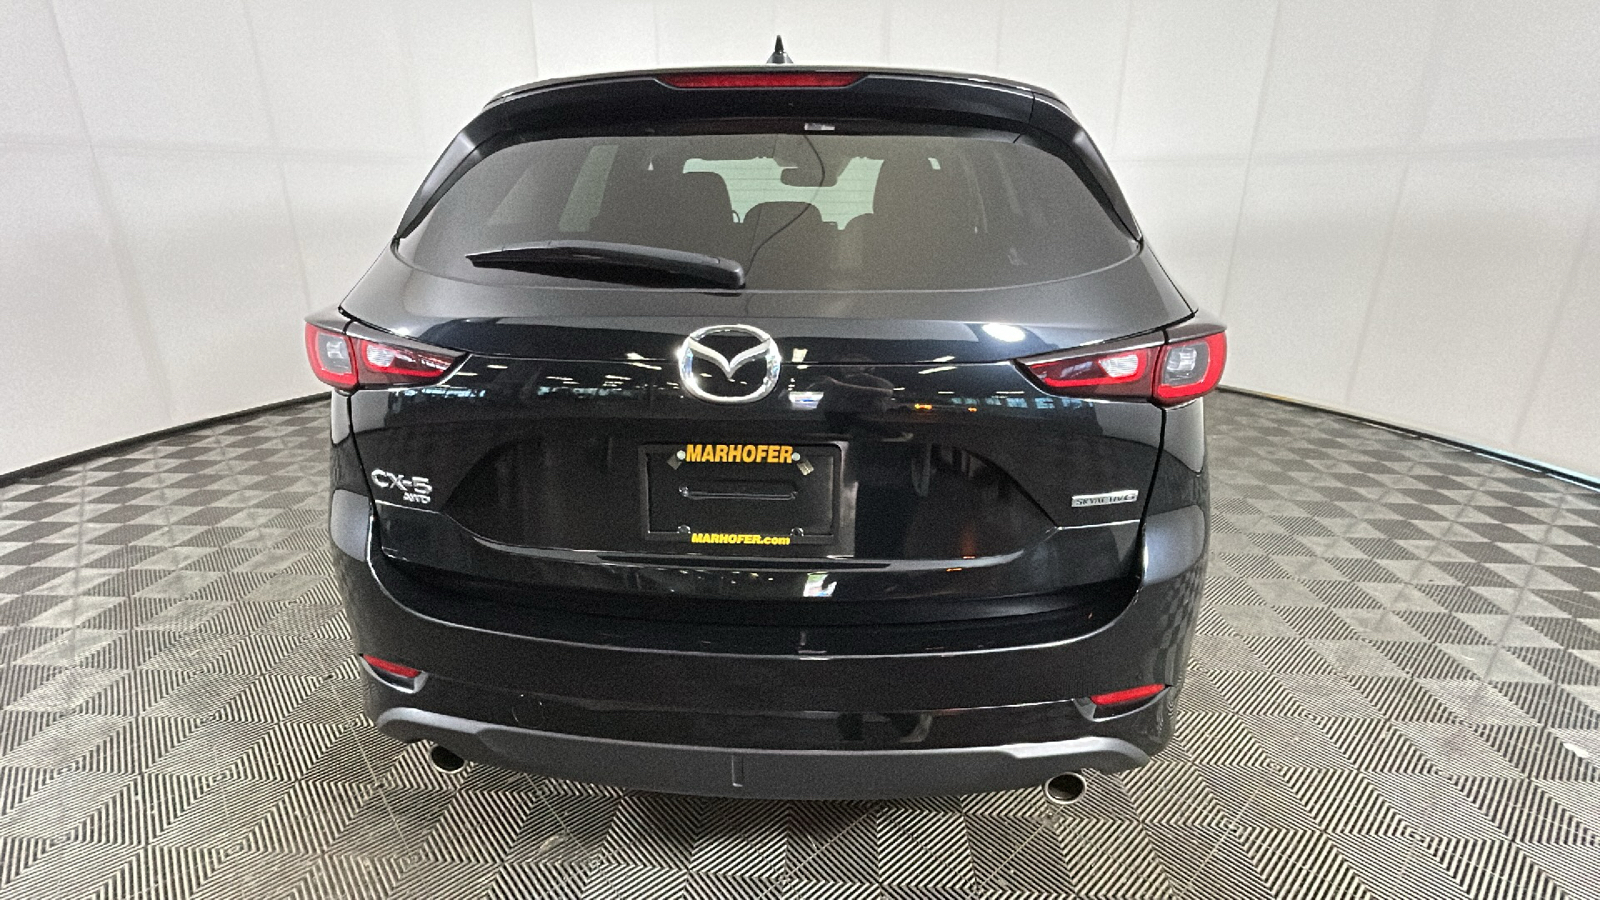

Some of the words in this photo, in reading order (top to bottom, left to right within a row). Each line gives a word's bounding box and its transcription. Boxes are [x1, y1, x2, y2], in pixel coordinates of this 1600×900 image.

[686, 444, 793, 463] MARHOFER
[371, 469, 433, 494] CX-5
[691, 533, 791, 545] MARHOFER.com
